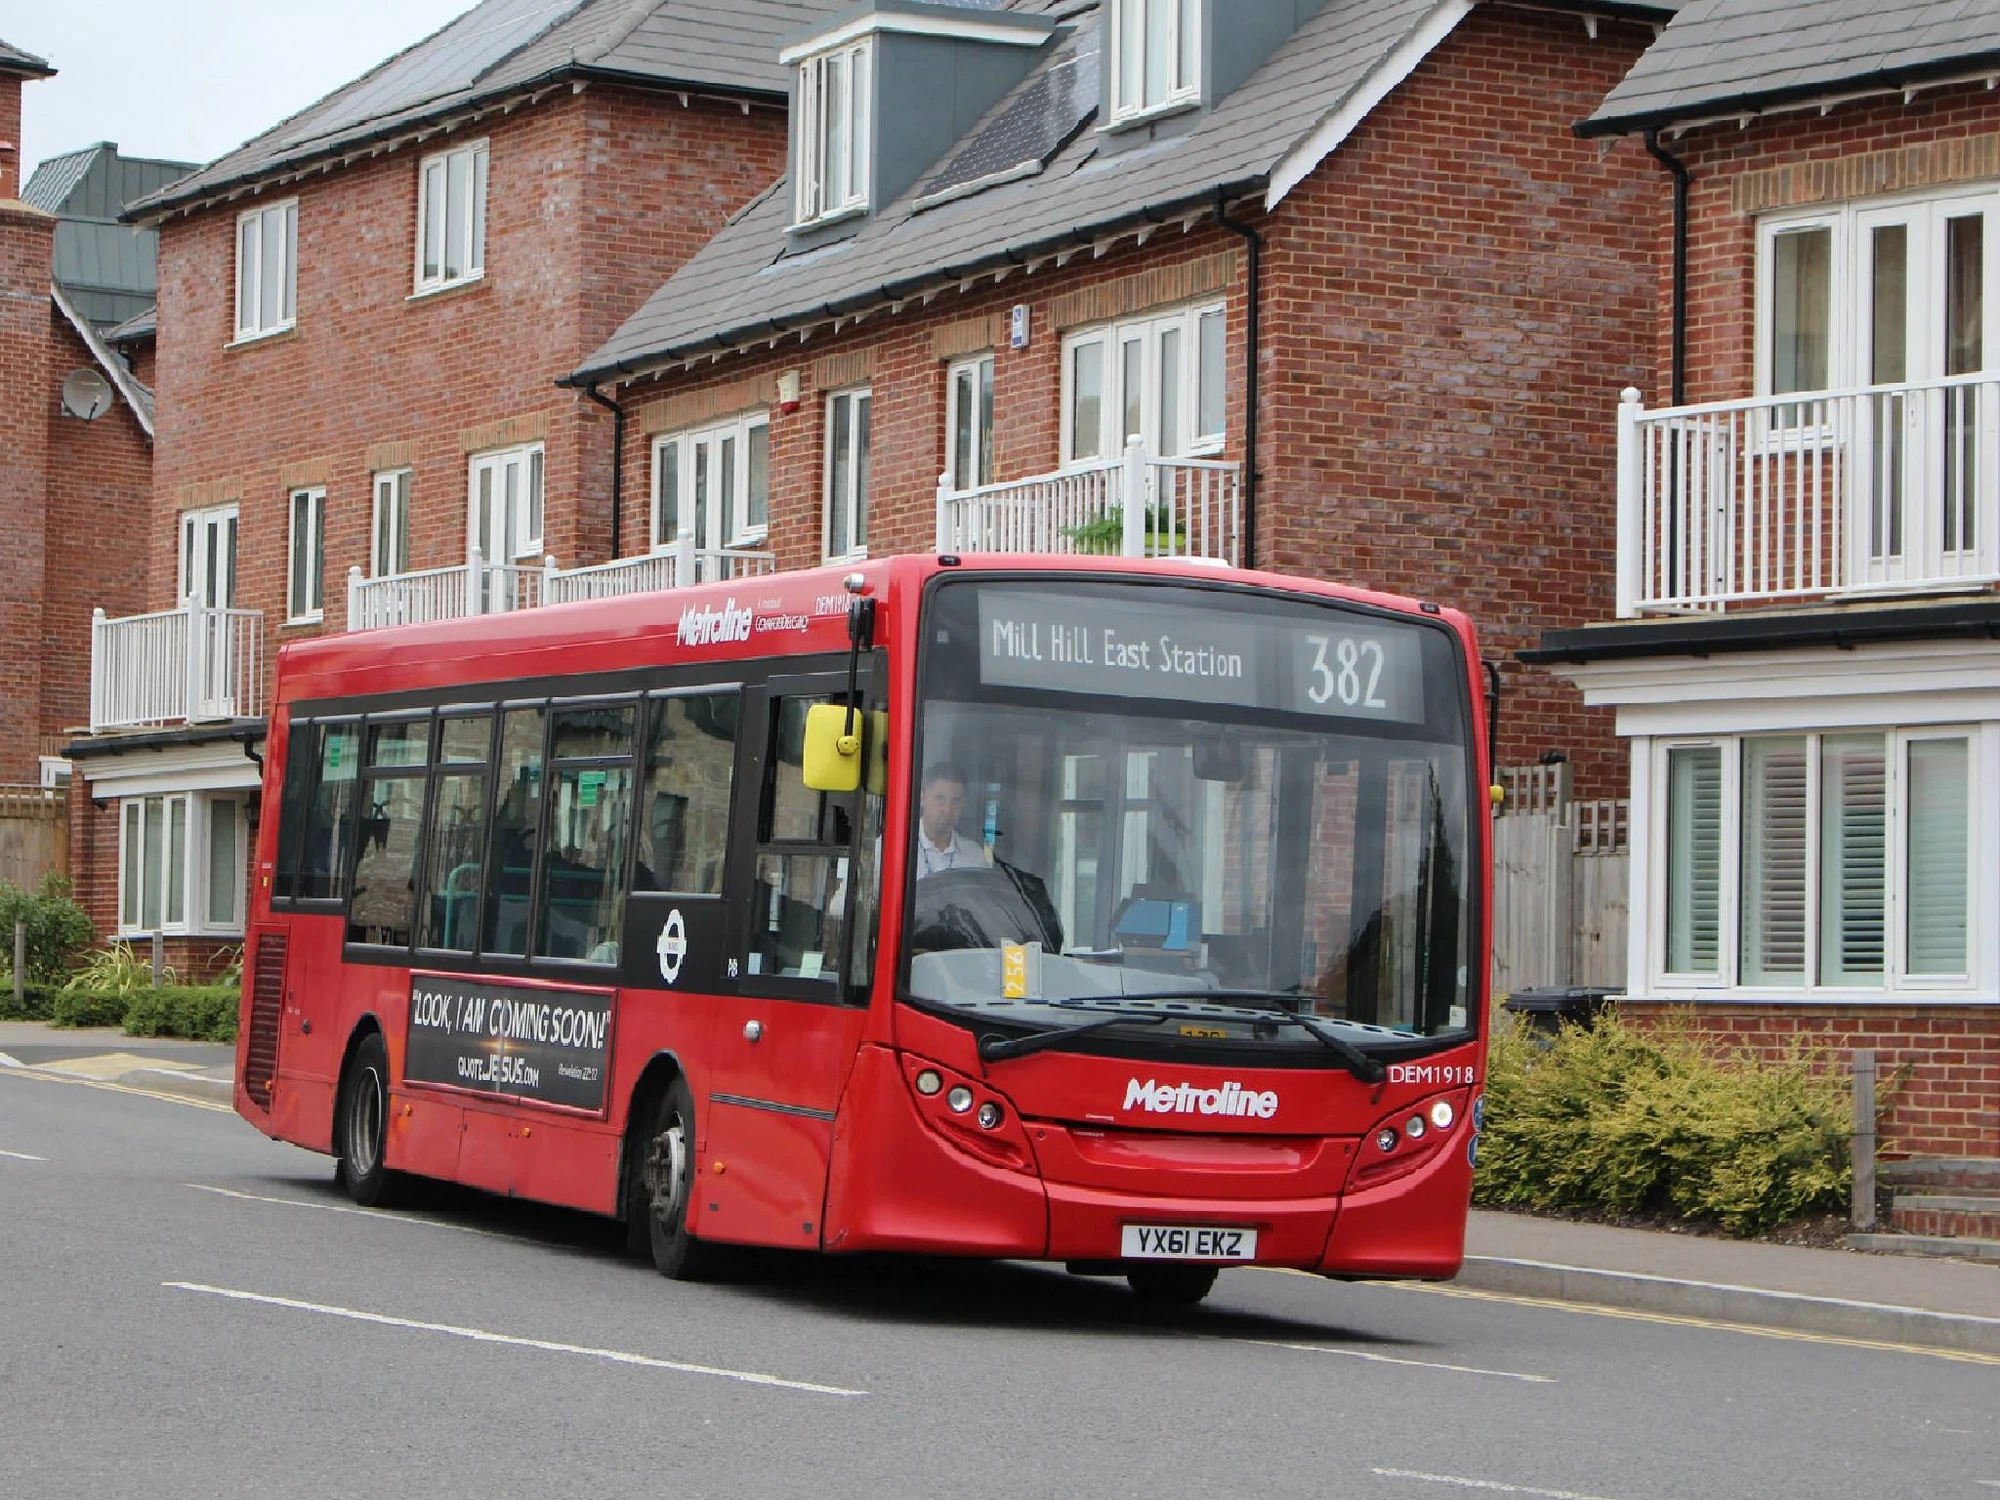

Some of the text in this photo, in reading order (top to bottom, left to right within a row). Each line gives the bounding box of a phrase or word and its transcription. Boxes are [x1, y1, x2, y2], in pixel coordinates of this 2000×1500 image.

[676, 597, 753, 647] Metroline
[992, 619, 1242, 678] Mill Hill East Station
[1307, 635, 1386, 708] 382
[1006, 951, 1024, 993] 256
[412, 989, 612, 1050] "LOOK, I AM COMING SOON!"
[1389, 1065, 1475, 1085] DEM1918
[1122, 1078, 1279, 1119] Metroline
[1138, 1228, 1242, 1258] YX61 EKZ
